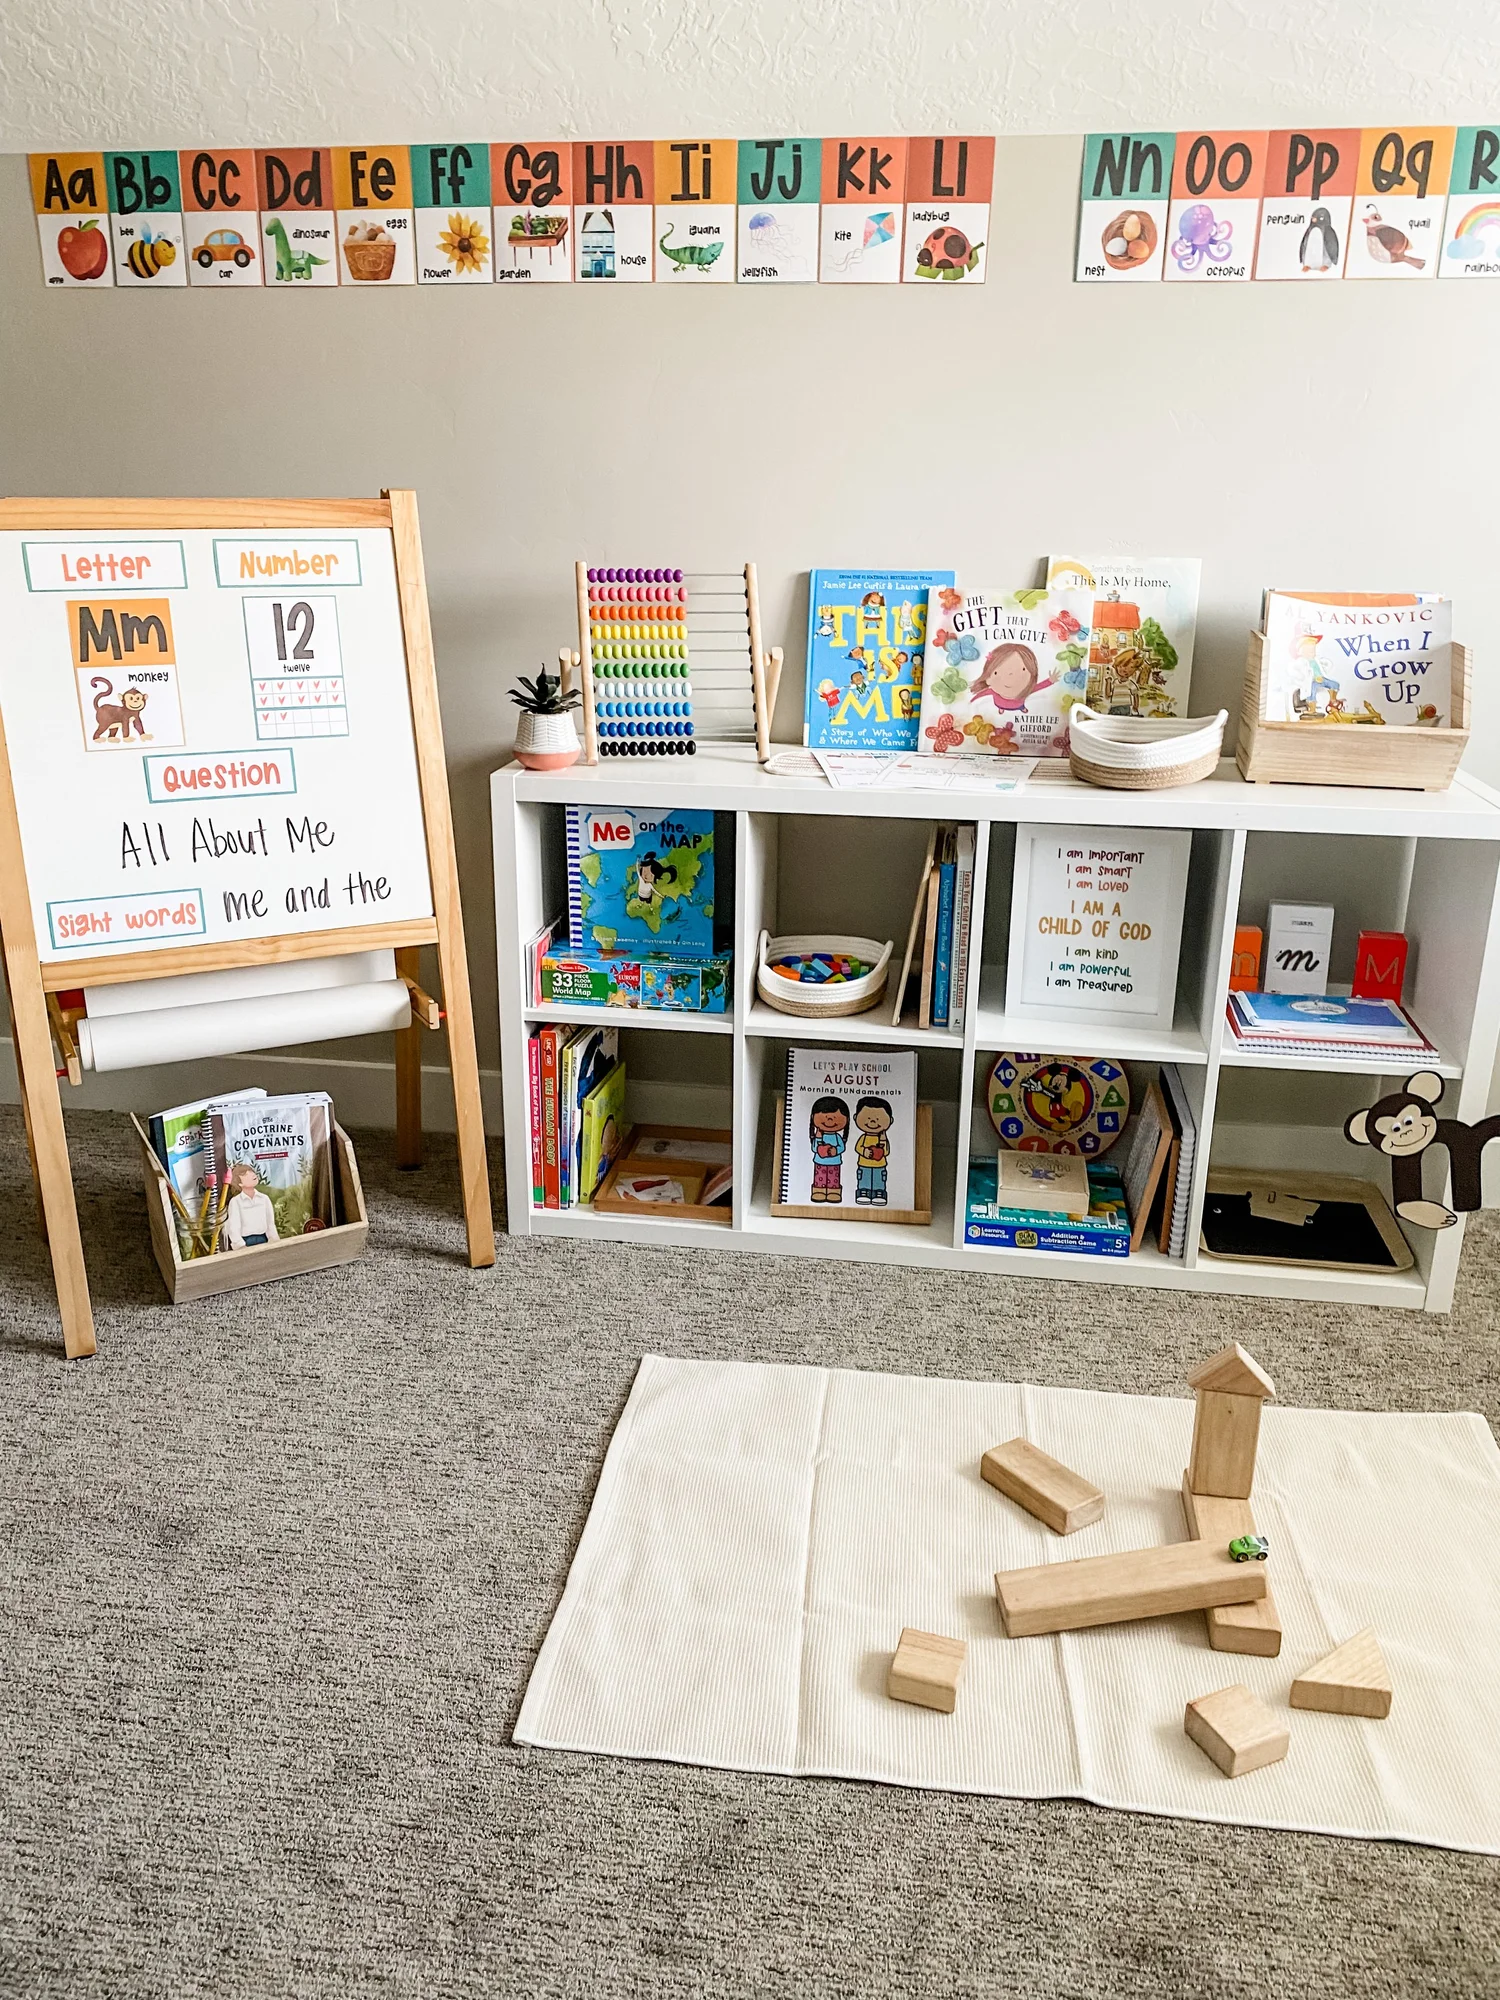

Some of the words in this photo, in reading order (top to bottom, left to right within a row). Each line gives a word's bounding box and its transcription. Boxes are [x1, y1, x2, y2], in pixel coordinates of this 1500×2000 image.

[670, 143, 711, 201] Ii
[751, 141, 801, 200] Jj
[838, 142, 891, 198] Kk
[933, 139, 966, 197] Ll
[1093, 136, 1163, 196] Nn
[1186, 135, 1252, 195] Oo
[1286, 135, 1339, 200] Pp
[1372, 133, 1433, 199] Qq
[192, 153, 240, 210] Cc
[265, 148, 320, 209] Dd
[350, 151, 396, 207] Ee
[431, 145, 472, 205] Ff
[504, 145, 563, 207] Gg
[586, 145, 642, 204] Hh
[44, 159, 97, 210] Aa
[114, 156, 171, 215] Bb
[913, 211, 950, 222] ladybug
[1266, 213, 1305, 227] penguin
[1409, 218, 1431, 229] quail
[386, 219, 407, 229] eggs
[689, 225, 720, 237] iguana
[119, 227, 134, 236] bee
[292, 228, 330, 240] dinosaur
[835, 230, 851, 241] kite
[621, 254, 646, 266] house
[219, 270, 233, 278] car
[423, 268, 452, 279] flower
[500, 268, 531, 281] garden
[742, 267, 778, 278] jellyfish
[1085, 265, 1105, 277] nest
[1207, 266, 1245, 277] octopus
[61, 553, 151, 581] Letter
[240, 550, 339, 578] Number
[822, 581, 846, 589] Jamie
[864, 582, 886, 590] Curtis
[1072, 575, 1096, 586] This
[1100, 576, 1110, 586] Is
[1113, 577, 1131, 589] My
[1135, 576, 1171, 588] Home,
[967, 596, 985, 607] THE
[953, 606, 1003, 632] GIFT
[1007, 616, 1029, 626] THAT
[1316, 609, 1433, 625] YANKOVIC
[273, 602, 315, 660] 12
[818, 605, 928, 647] THIS
[79, 606, 168, 662] Mm
[985, 629, 988, 640] I
[993, 629, 1015, 640] CAN
[1020, 630, 1047, 644] GIVE
[1334, 634, 1410, 657] When
[1419, 631, 1432, 650] I
[283, 663, 310, 673] twelve
[867, 647, 898, 683] IS
[1354, 660, 1433, 680] Grow
[128, 671, 169, 683] monkey
[1383, 680, 1421, 704] Up
[830, 685, 921, 725] ME
[1046, 716, 1059, 724] LEE
[832, 728, 853, 737] Story
[872, 729, 892, 737] Who
[164, 761, 281, 792] Question
[593, 822, 630, 842] Me
[639, 822, 656, 831] on
[661, 822, 684, 833] the
[121, 822, 170, 869] All
[192, 818, 268, 862] About
[286, 818, 334, 853] Me
[660, 835, 703, 848] MAP
[1059, 848, 1061, 858] I
[1067, 850, 1083, 859] am
[1067, 864, 1069, 874] I
[1076, 866, 1091, 874] am
[1068, 879, 1070, 889] I
[1077, 881, 1092, 889] am
[223, 889, 268, 923] me
[286, 877, 331, 914] and
[342, 871, 391, 905] the
[943, 879, 951, 908] Alphabet
[1071, 900, 1074, 913] I
[1083, 901, 1104, 915] AM
[1112, 903, 1121, 916] A
[126, 902, 197, 929] words
[941, 911, 949, 933] Picture
[1039, 917, 1082, 935] CHILD
[1092, 920, 1110, 938] OF
[1120, 922, 1151, 940] GOD
[1066, 947, 1068, 956] I
[1075, 948, 1090, 957] am
[1050, 961, 1053, 970] I
[1059, 964, 1074, 972] am
[1275, 949, 1320, 972] m
[958, 968, 966, 981] Easy
[1365, 954, 1399, 984] M
[552, 973, 572, 987] 33
[1047, 977, 1049, 986] I
[1055, 979, 1070, 987] am
[575, 987, 591, 997] Map
[813, 1062, 835, 1071] LET'S
[839, 1062, 858, 1071] PLAY
[862, 1064, 891, 1072] SCHOOL
[998, 1068, 1015, 1080] 10
[1102, 1065, 1111, 1076] 2
[545, 1077, 553, 1094] THE
[824, 1074, 879, 1086] AUGUST
[800, 1086, 835, 1094] Morning
[839, 1088, 901, 1096] FUNdamentals
[1108, 1092, 1118, 1102] 3
[999, 1099, 1008, 1111] 9
[545, 1098, 554, 1135] HUMAN
[243, 1125, 293, 1137] DOCTRINE
[1008, 1123, 1017, 1134] 8
[234, 1135, 304, 1151] COVENANTS
[1086, 1137, 1094, 1148] 5
[547, 1139, 555, 1166] BODY
[1040, 1237, 1076, 1245] Subtraction
[1115, 1239, 1127, 1248] 5+
